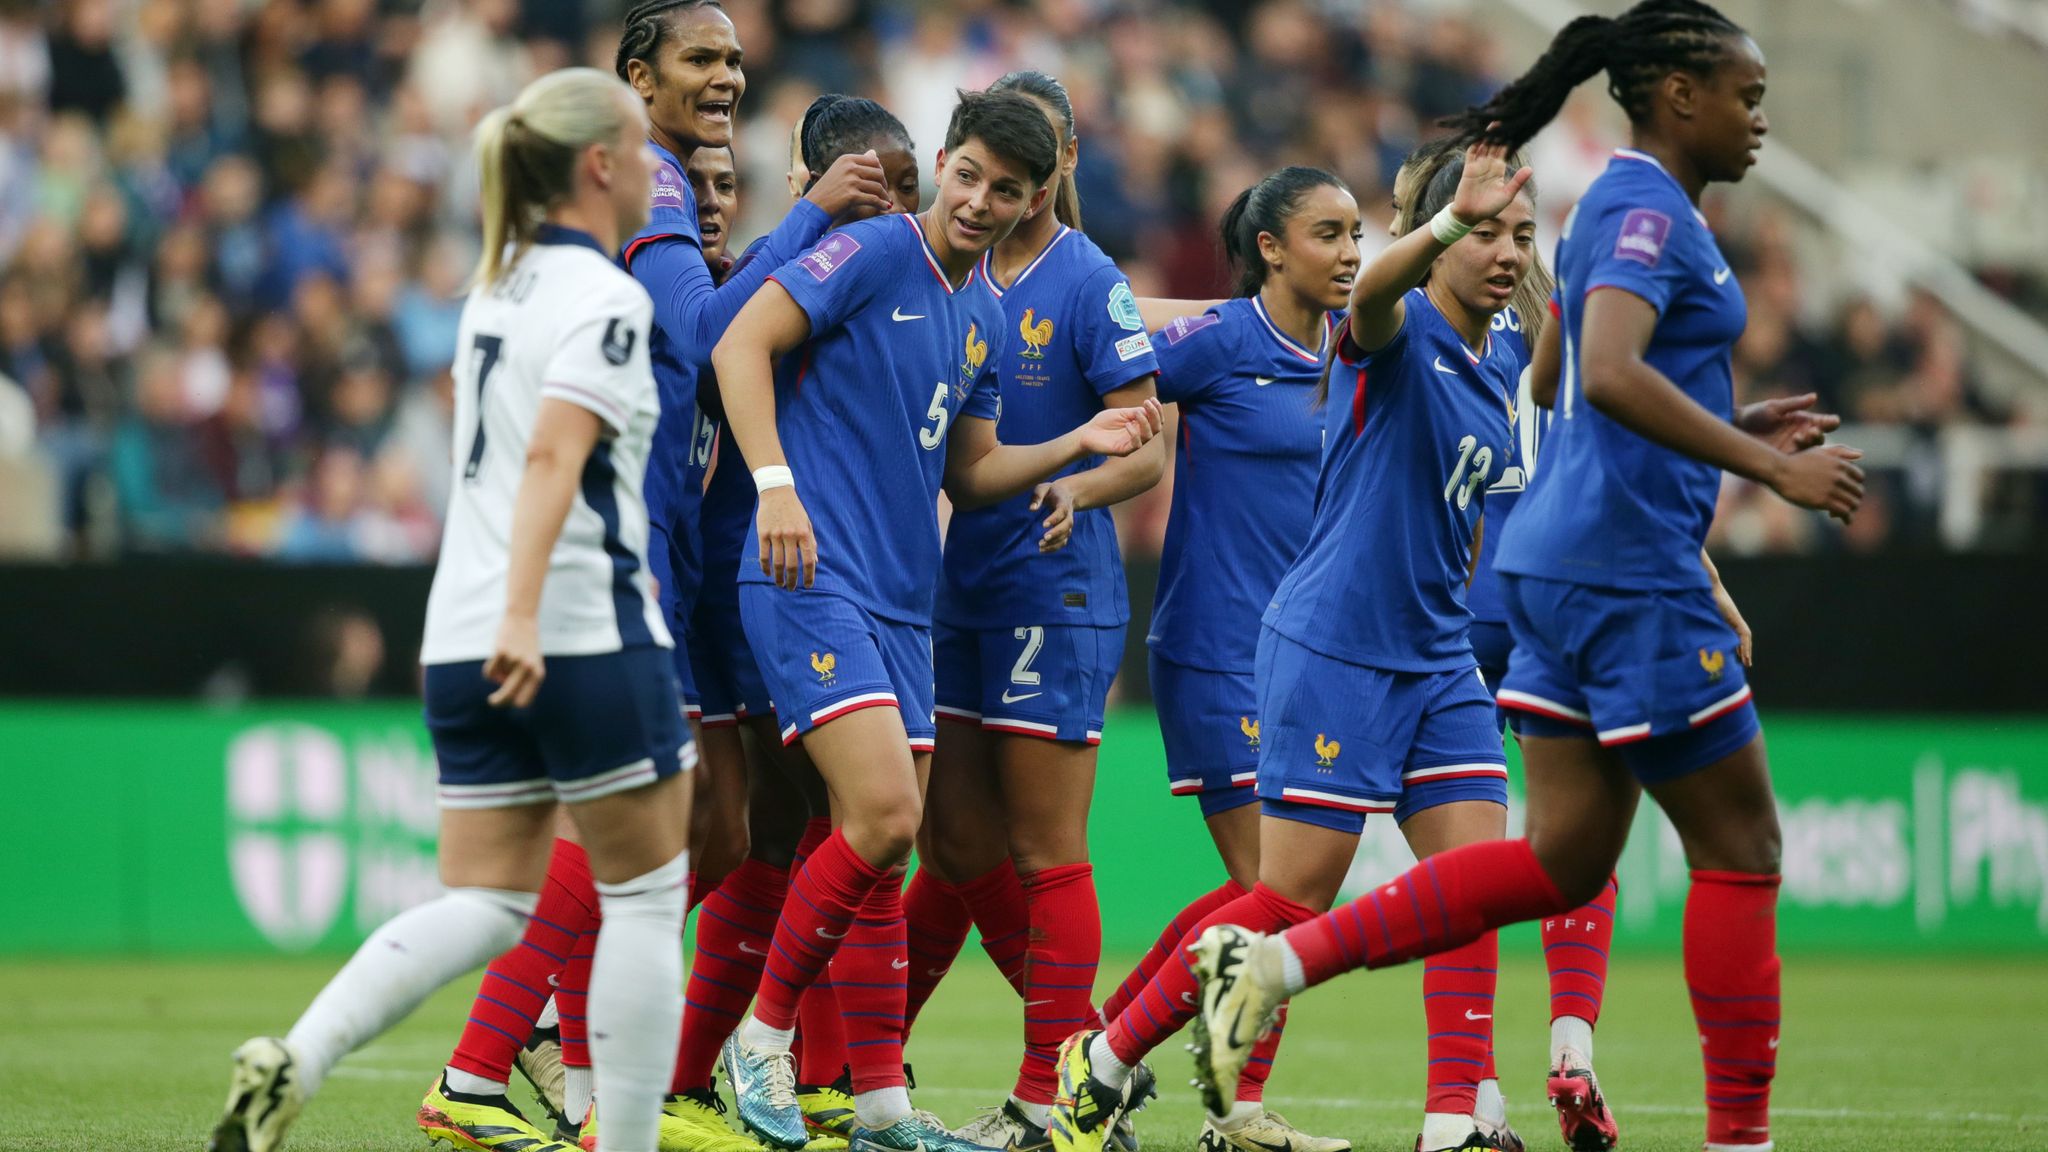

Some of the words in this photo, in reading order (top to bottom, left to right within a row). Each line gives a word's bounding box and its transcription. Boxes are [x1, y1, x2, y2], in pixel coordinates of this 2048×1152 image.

[1119, 339, 1148, 354] FOUN
[464, 333, 504, 481] 7
[919, 382, 948, 450] 5
[1444, 434, 1493, 511] 13
[1010, 625, 1044, 685] 2
